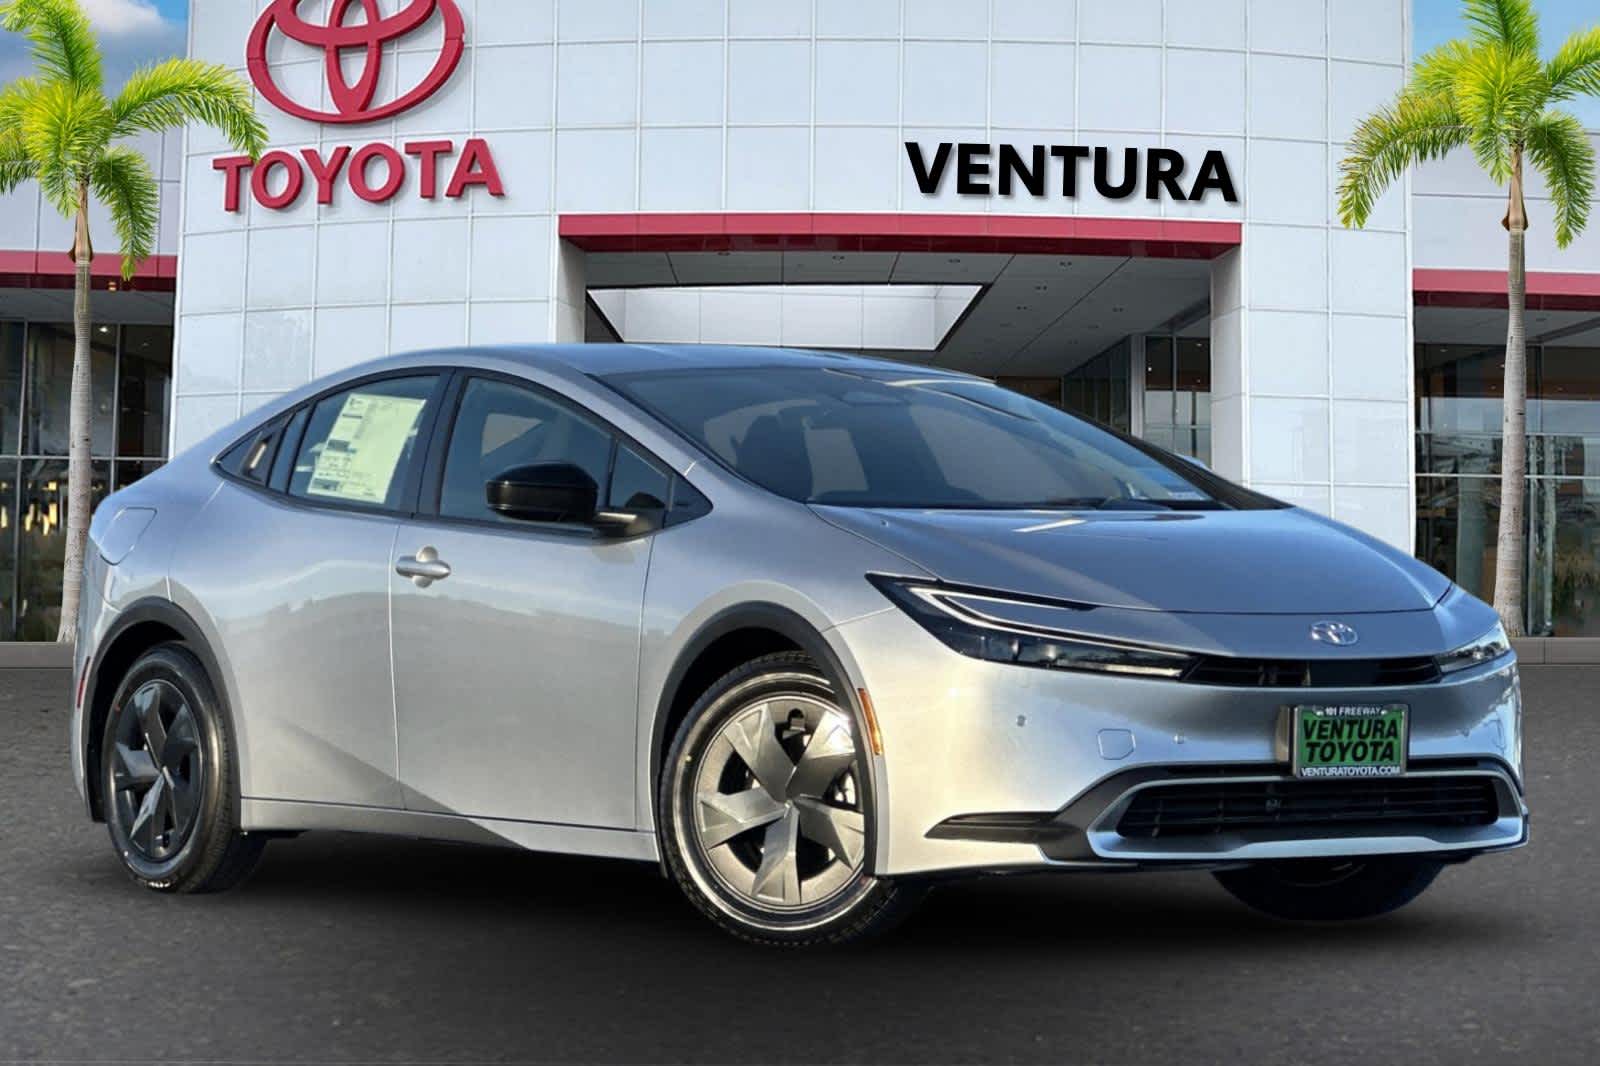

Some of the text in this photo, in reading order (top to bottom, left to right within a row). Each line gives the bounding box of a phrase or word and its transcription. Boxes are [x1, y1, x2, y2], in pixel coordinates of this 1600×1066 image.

[213, 138, 505, 213] TOYOTA
[904, 142, 1238, 202] VENTURA
[1339, 706, 1381, 716] FREEWAY
[1303, 719, 1398, 740] VENTURA
[1306, 741, 1394, 762] TOYOTA
[1301, 765, 1400, 777] VENTURATOYOTA.COM
